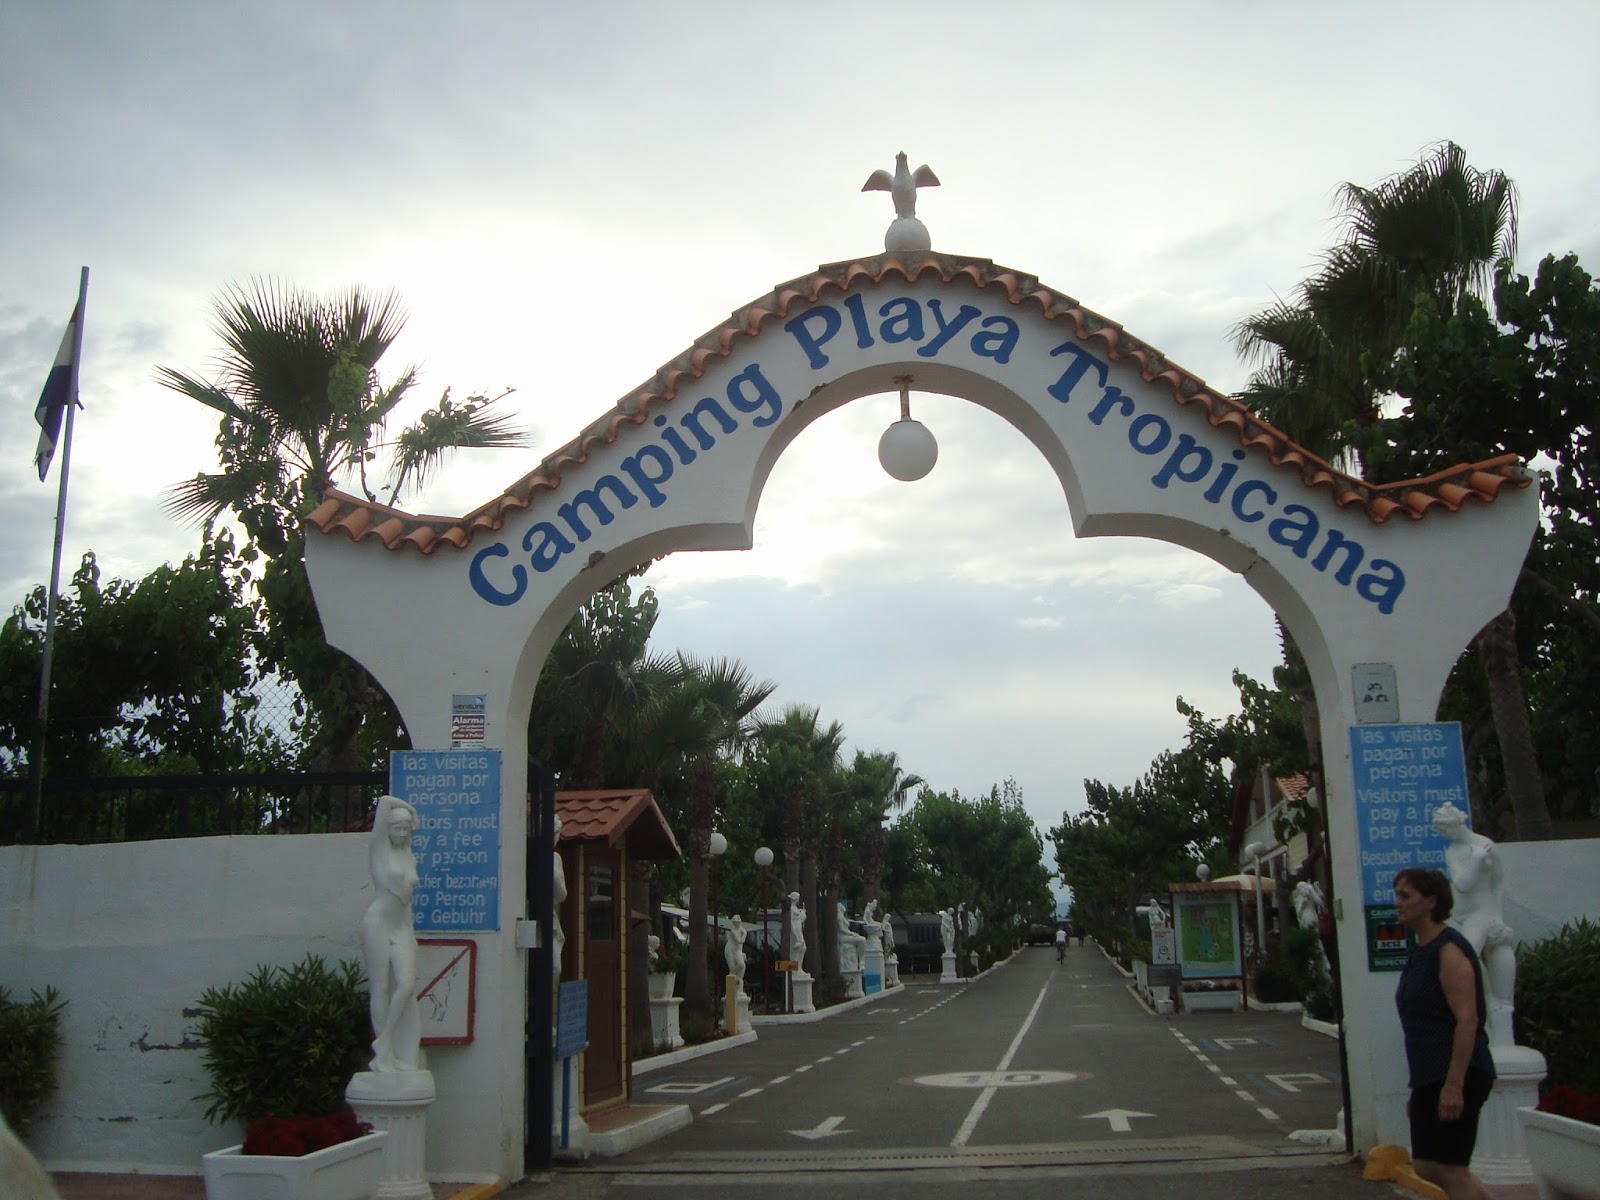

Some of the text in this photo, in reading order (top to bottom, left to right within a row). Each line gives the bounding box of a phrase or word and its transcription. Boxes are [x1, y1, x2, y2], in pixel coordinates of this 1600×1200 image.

[469, 293, 1406, 615] Camping Playa Tropicana
[453, 716, 484, 724] Alarma
[1360, 727, 1443, 744] las visitas
[403, 754, 489, 771] las visitas
[1363, 746, 1447, 765] pagan por
[1369, 764, 1442, 783] persona
[406, 774, 489, 791] pagan por
[408, 792, 481, 805] persona
[1358, 785, 1464, 803] Visitors must
[459, 813, 498, 829] must
[1370, 807, 1400, 824] pay
[1406, 806, 1417, 820] a
[412, 831, 482, 850] ay a fee
[1369, 824, 1440, 843] per pers
[413, 851, 488, 868] er person
[1361, 849, 1412, 866] Besucher
[435, 891, 485, 906] Person
[1264, 1073, 1331, 1093] P
